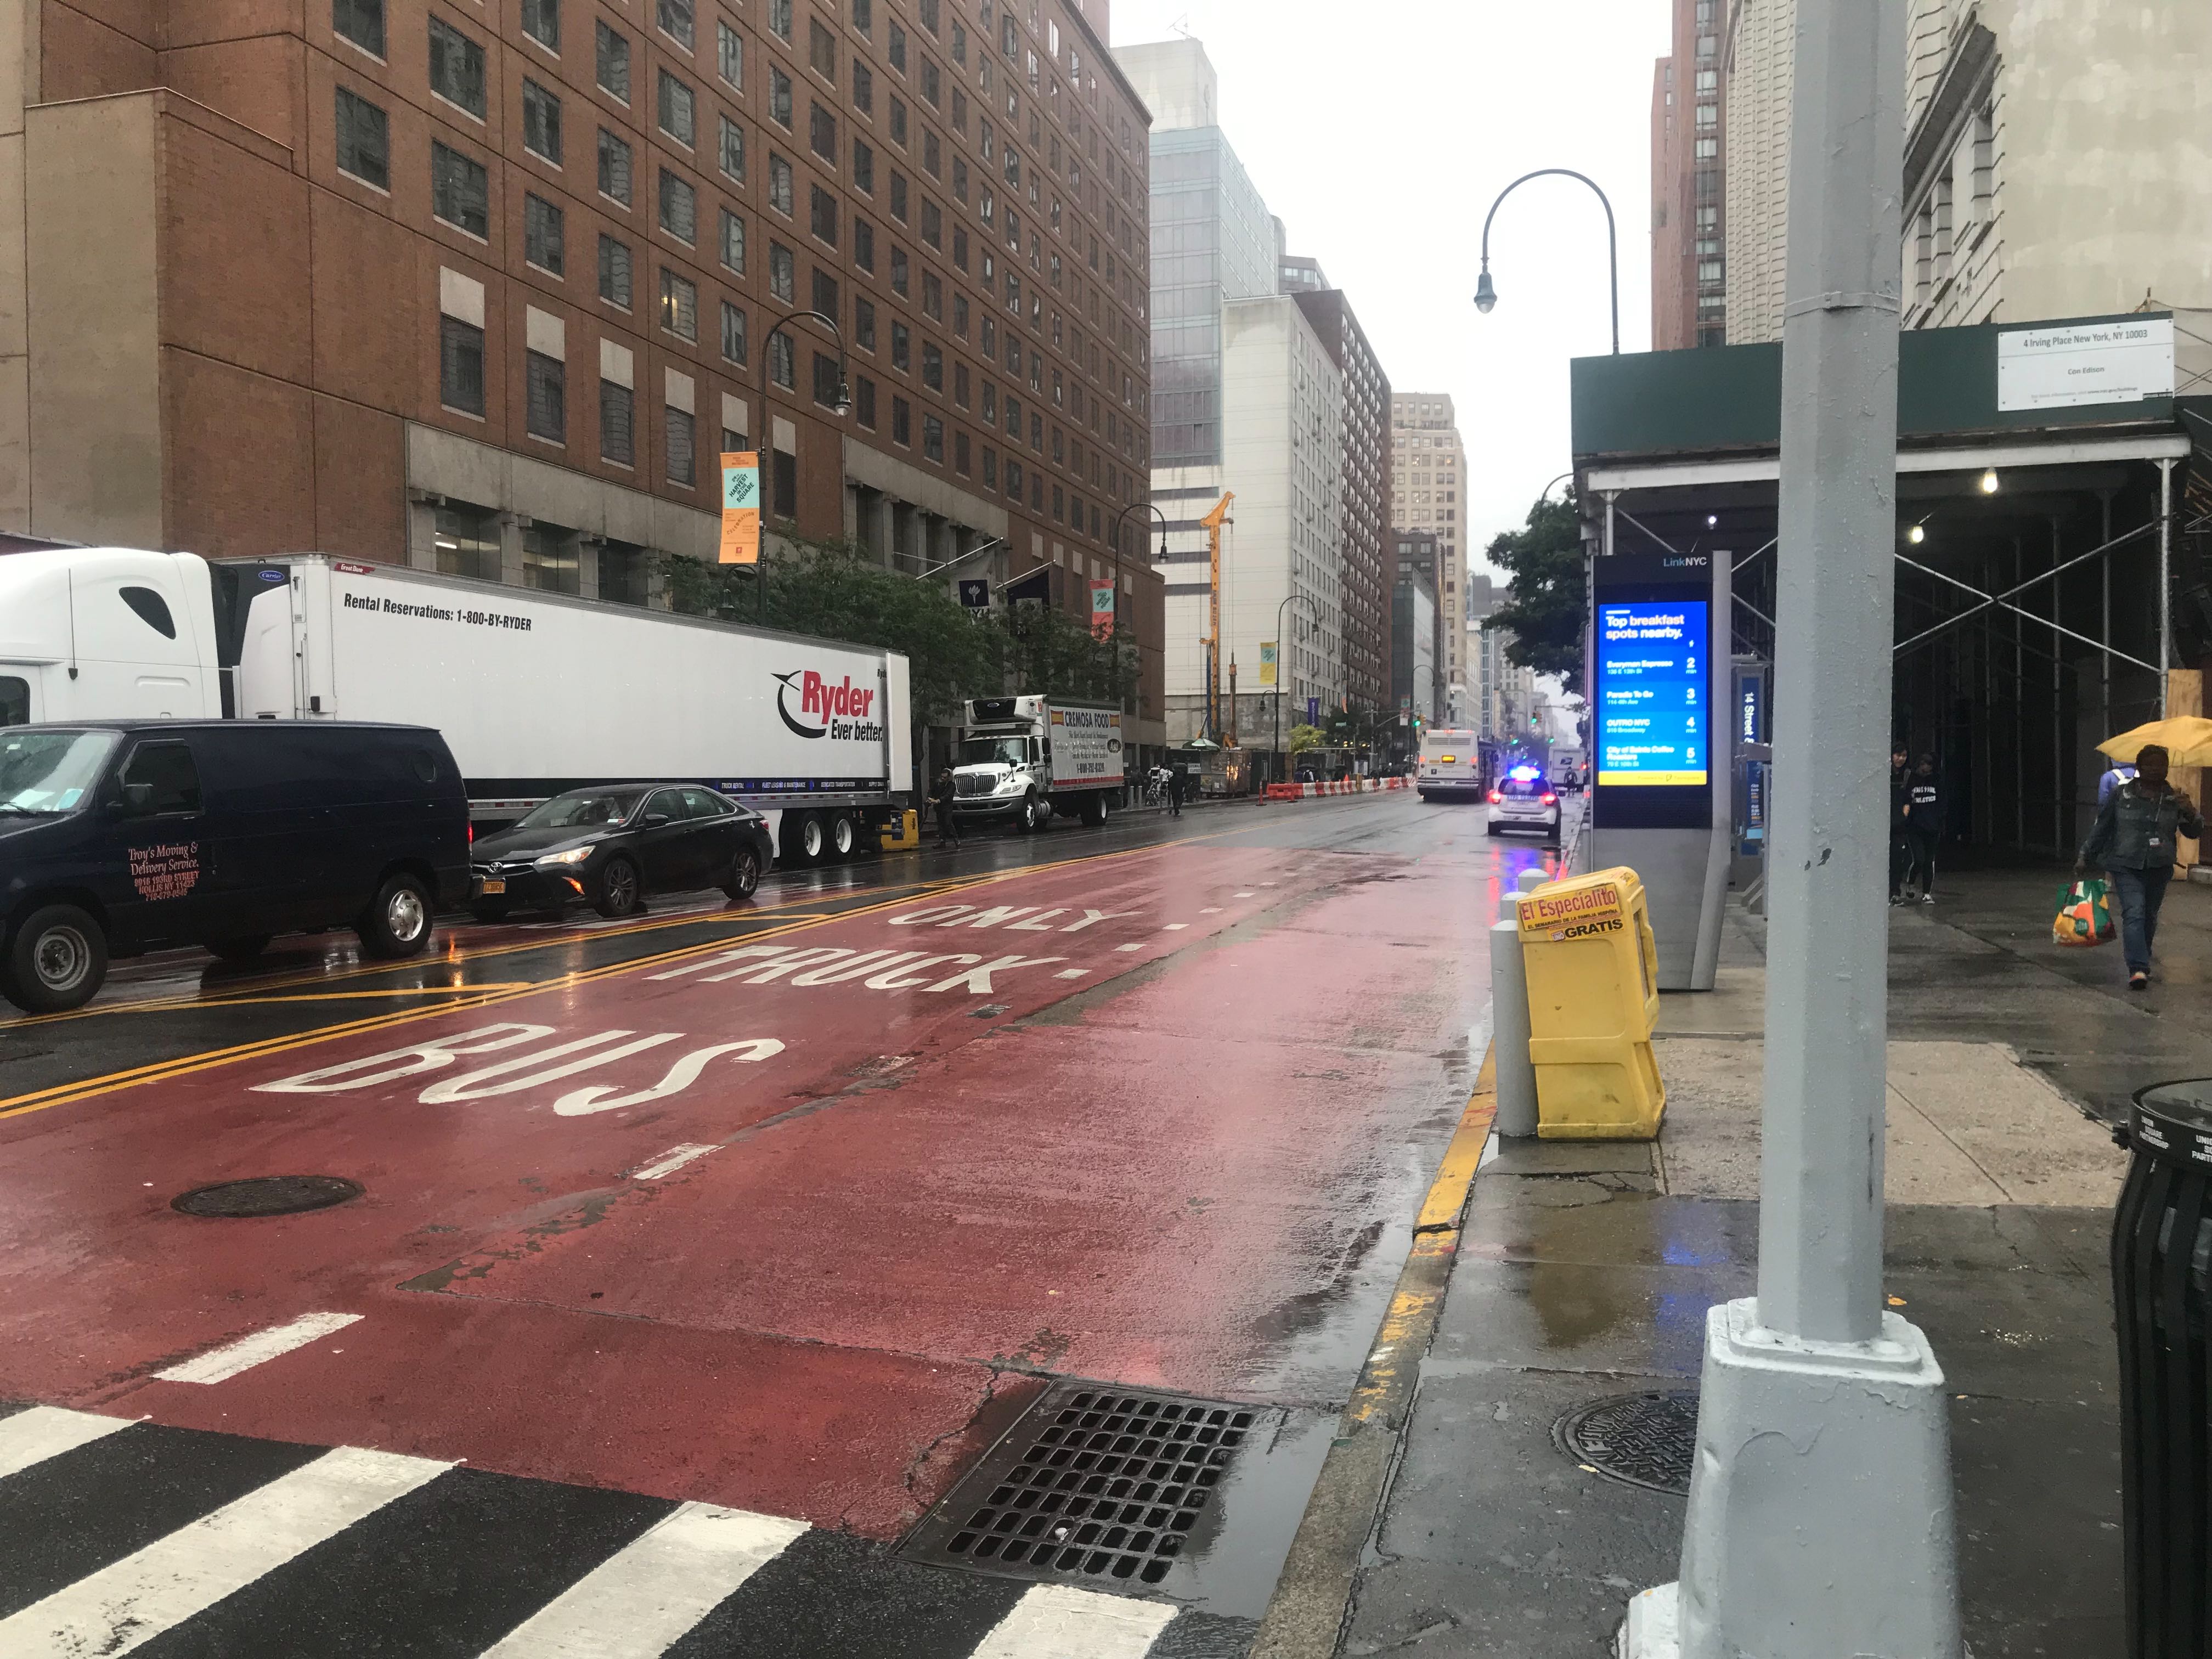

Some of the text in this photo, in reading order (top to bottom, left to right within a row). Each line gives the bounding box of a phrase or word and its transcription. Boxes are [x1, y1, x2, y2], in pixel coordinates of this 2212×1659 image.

[2030, 337, 2051, 348] Irving
[2052, 336, 2072, 345] Place
[2074, 335, 2090, 343] New
[2092, 333, 2111, 342] York,
[2125, 330, 2148, 339] 10003
[2083, 366, 2104, 374] Edison
[729, 473, 748, 497] HARVEST
[737, 482, 754, 503] SQUARE
[1663, 557, 1707, 567] LinkNYC
[344, 593, 532, 631] Rental Reservations: 1-800-BY-RYDER
[1606, 614, 1685, 629] Top breakfast
[1606, 627, 1683, 641] spots nearby.
[1606, 657, 1695, 669] Everyman Espresso 2
[802, 670, 873, 725] Ryder
[1686, 688, 1695, 699] 3
[1745, 691, 1754, 703] 14
[1065, 711, 1109, 729] CREMOSA FOOD
[1686, 716, 1695, 727] 4
[1744, 705, 1754, 736] Street
[831, 719, 883, 742] Ever better.
[1606, 746, 1621, 754] City
[1686, 747, 1695, 758] 5
[128, 841, 198, 862] Troy's Moving &
[131, 860, 167, 876] Delivery
[174, 870, 200, 881] STREET
[139, 883, 163, 894] HOLLIS
[165, 881, 174, 890] NY
[1521, 888, 1616, 921] El Especialito
[888, 904, 1143, 933] ONLY
[1535, 919, 1562, 928] SEMANARIO
[1565, 918, 1623, 938] GRATIS
[641, 944, 1069, 994] TRUCK
[247, 1022, 785, 1116] BUS
